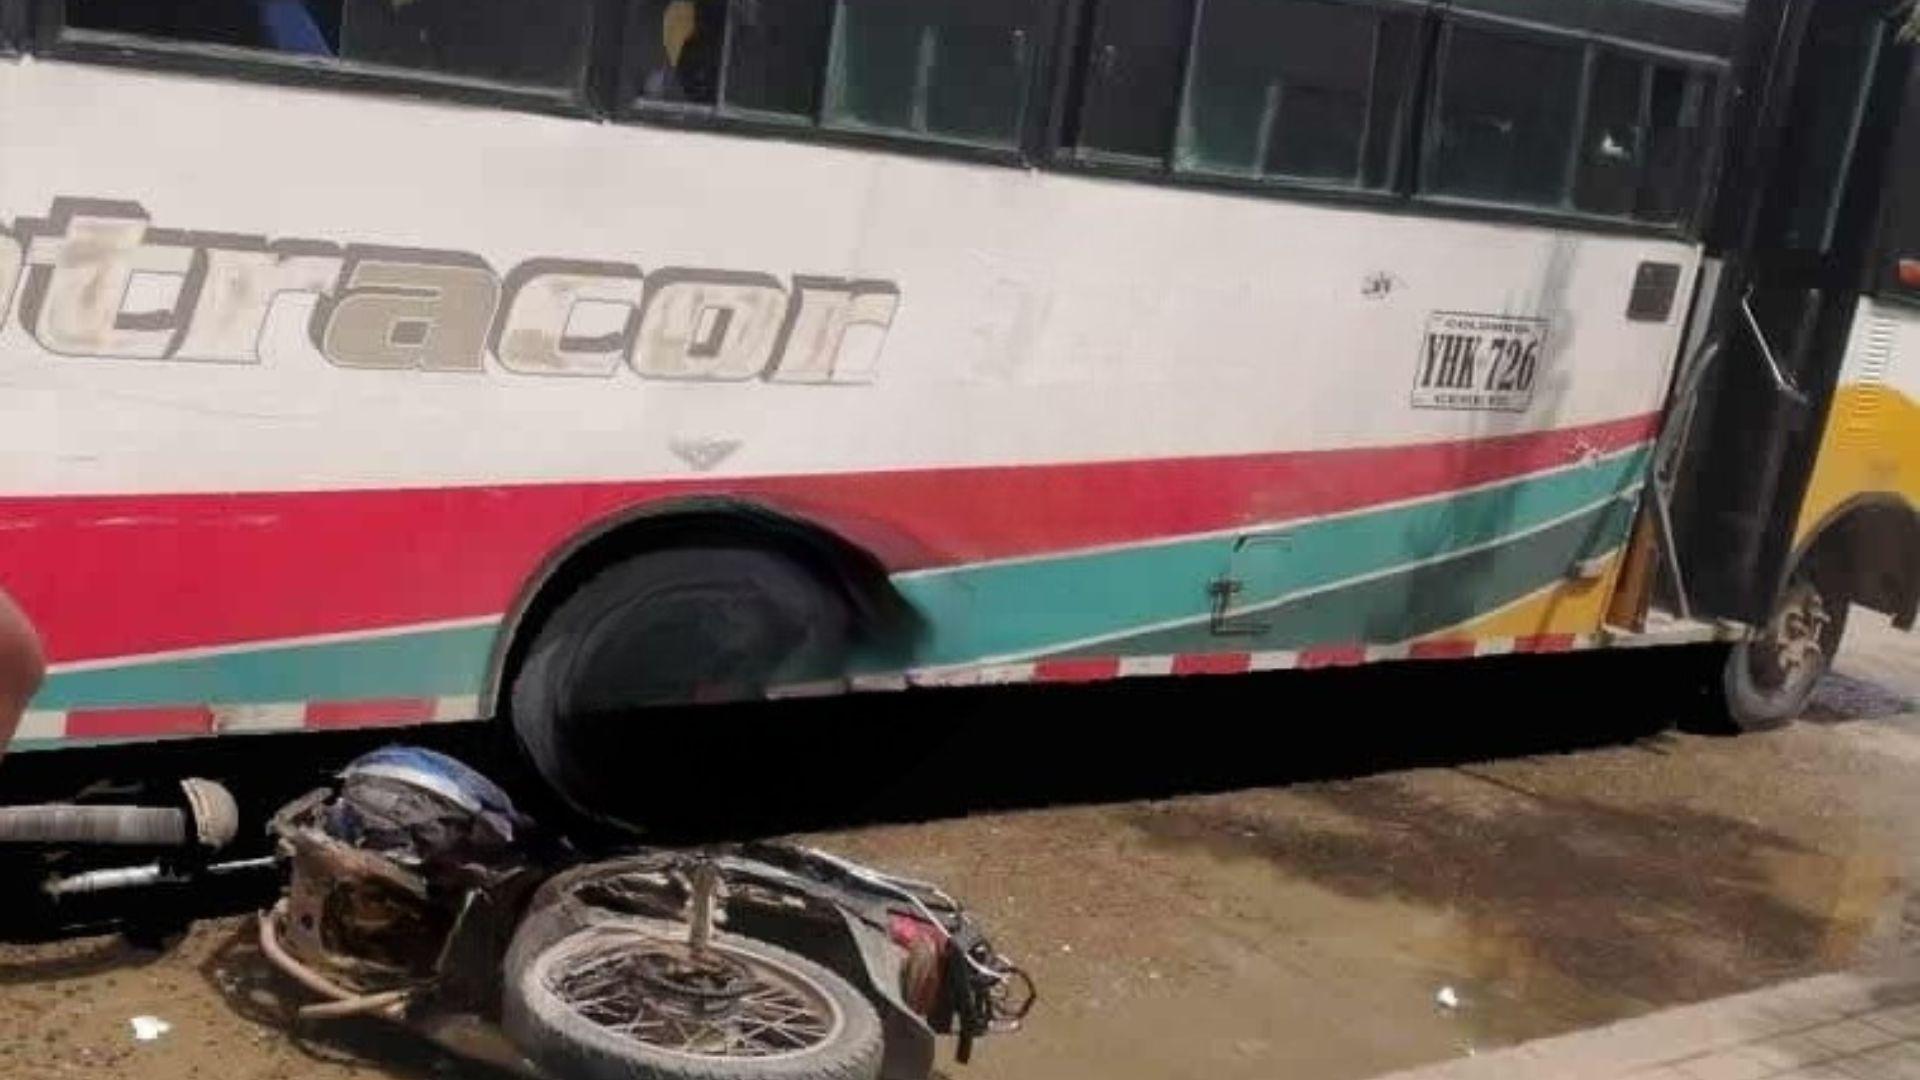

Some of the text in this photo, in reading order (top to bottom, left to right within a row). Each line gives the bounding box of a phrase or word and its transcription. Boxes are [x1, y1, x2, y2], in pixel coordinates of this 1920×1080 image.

[0, 196, 900, 385] tracor
[1420, 334, 1538, 391] YHK 726
